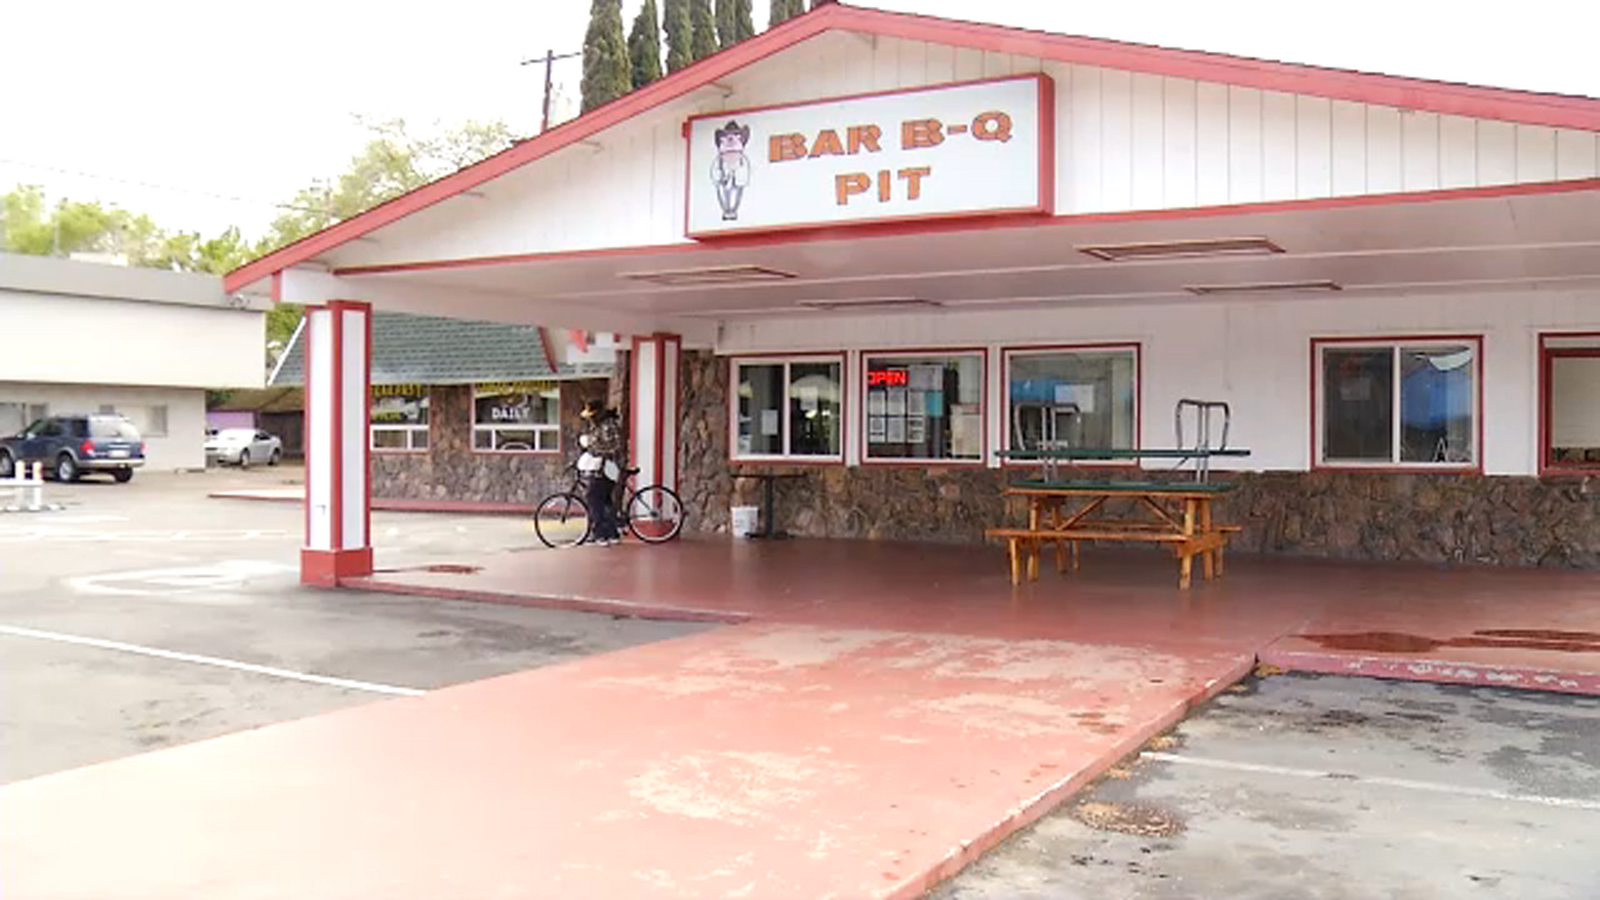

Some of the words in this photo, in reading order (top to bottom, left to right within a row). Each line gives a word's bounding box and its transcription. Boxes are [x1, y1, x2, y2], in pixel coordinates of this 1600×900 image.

[768, 124, 882, 163] BAR
[901, 111, 1013, 150] B-Q
[835, 166, 932, 206] PIT
[491, 406, 530, 420] DAILY
